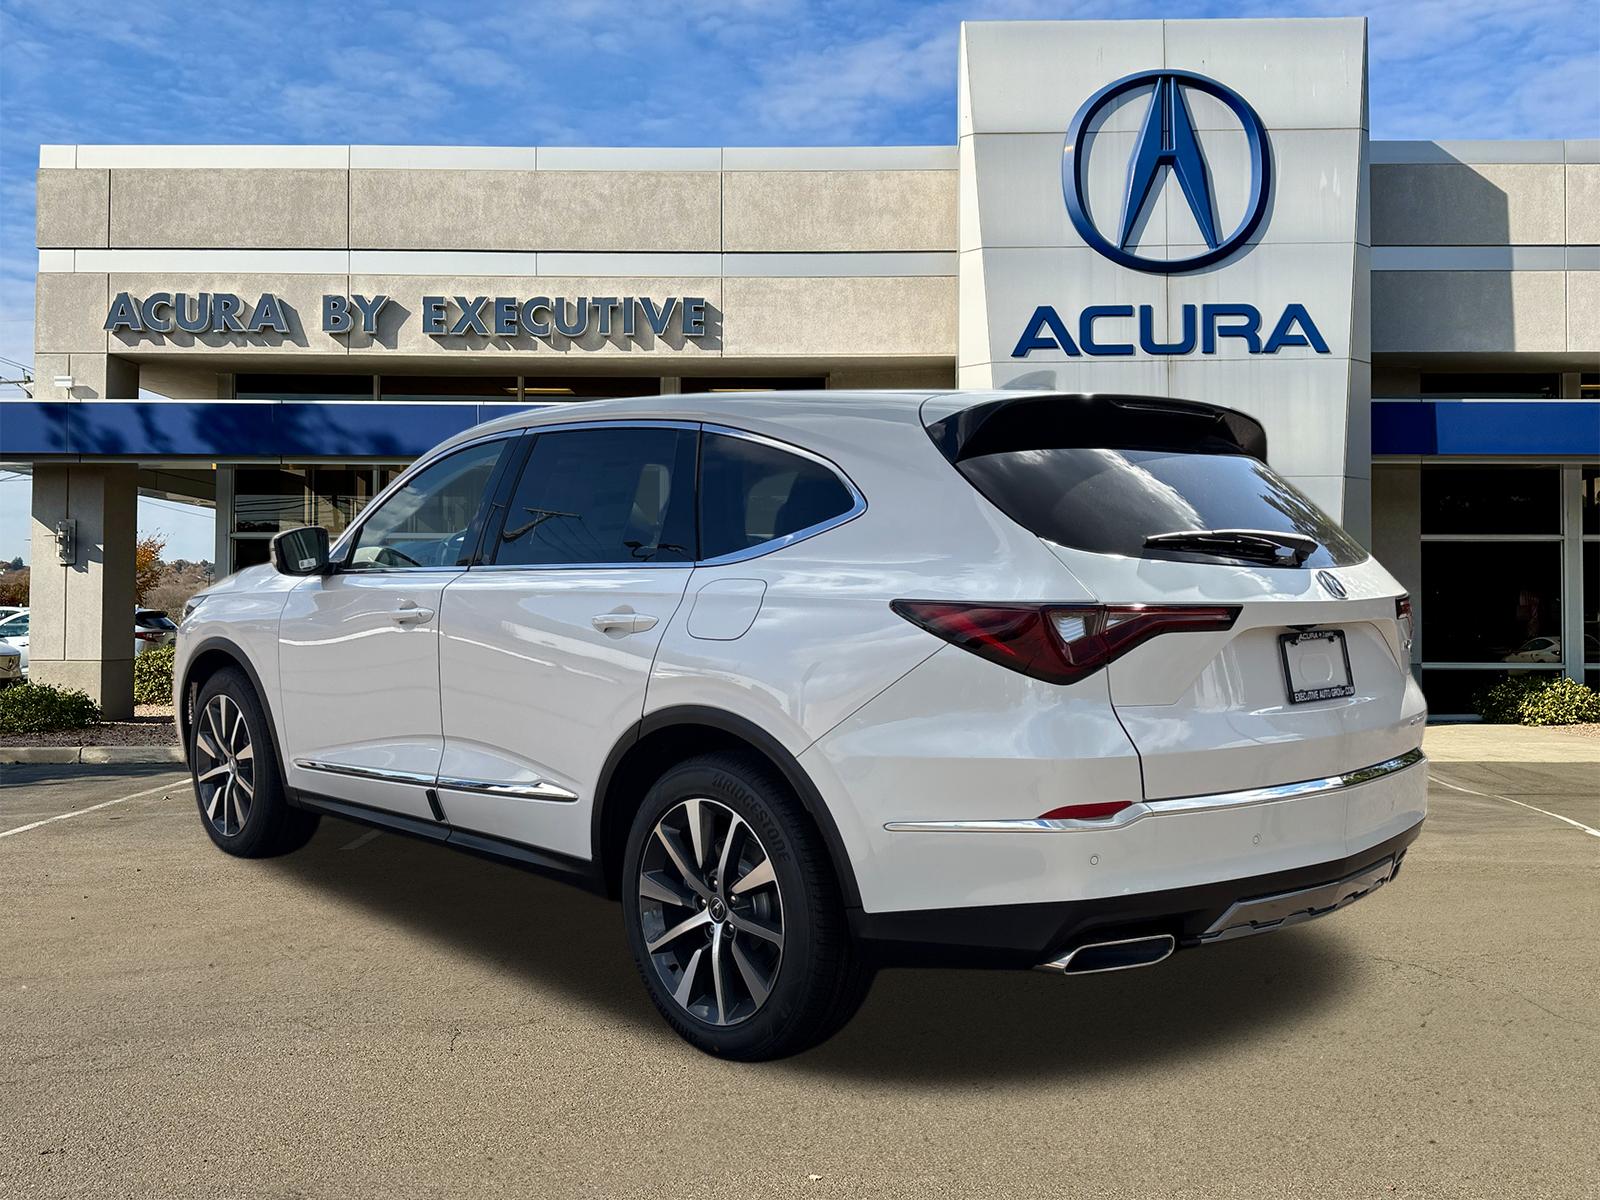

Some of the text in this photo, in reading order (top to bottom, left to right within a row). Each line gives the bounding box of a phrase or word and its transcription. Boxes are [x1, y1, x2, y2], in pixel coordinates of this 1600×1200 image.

[104, 291, 706, 337] ACURA BY EXECUTIVE
[1011, 303, 1331, 357] ACURA
[1298, 632, 1318, 641] ACURA
[712, 773, 791, 863] BRIDGESTONE
